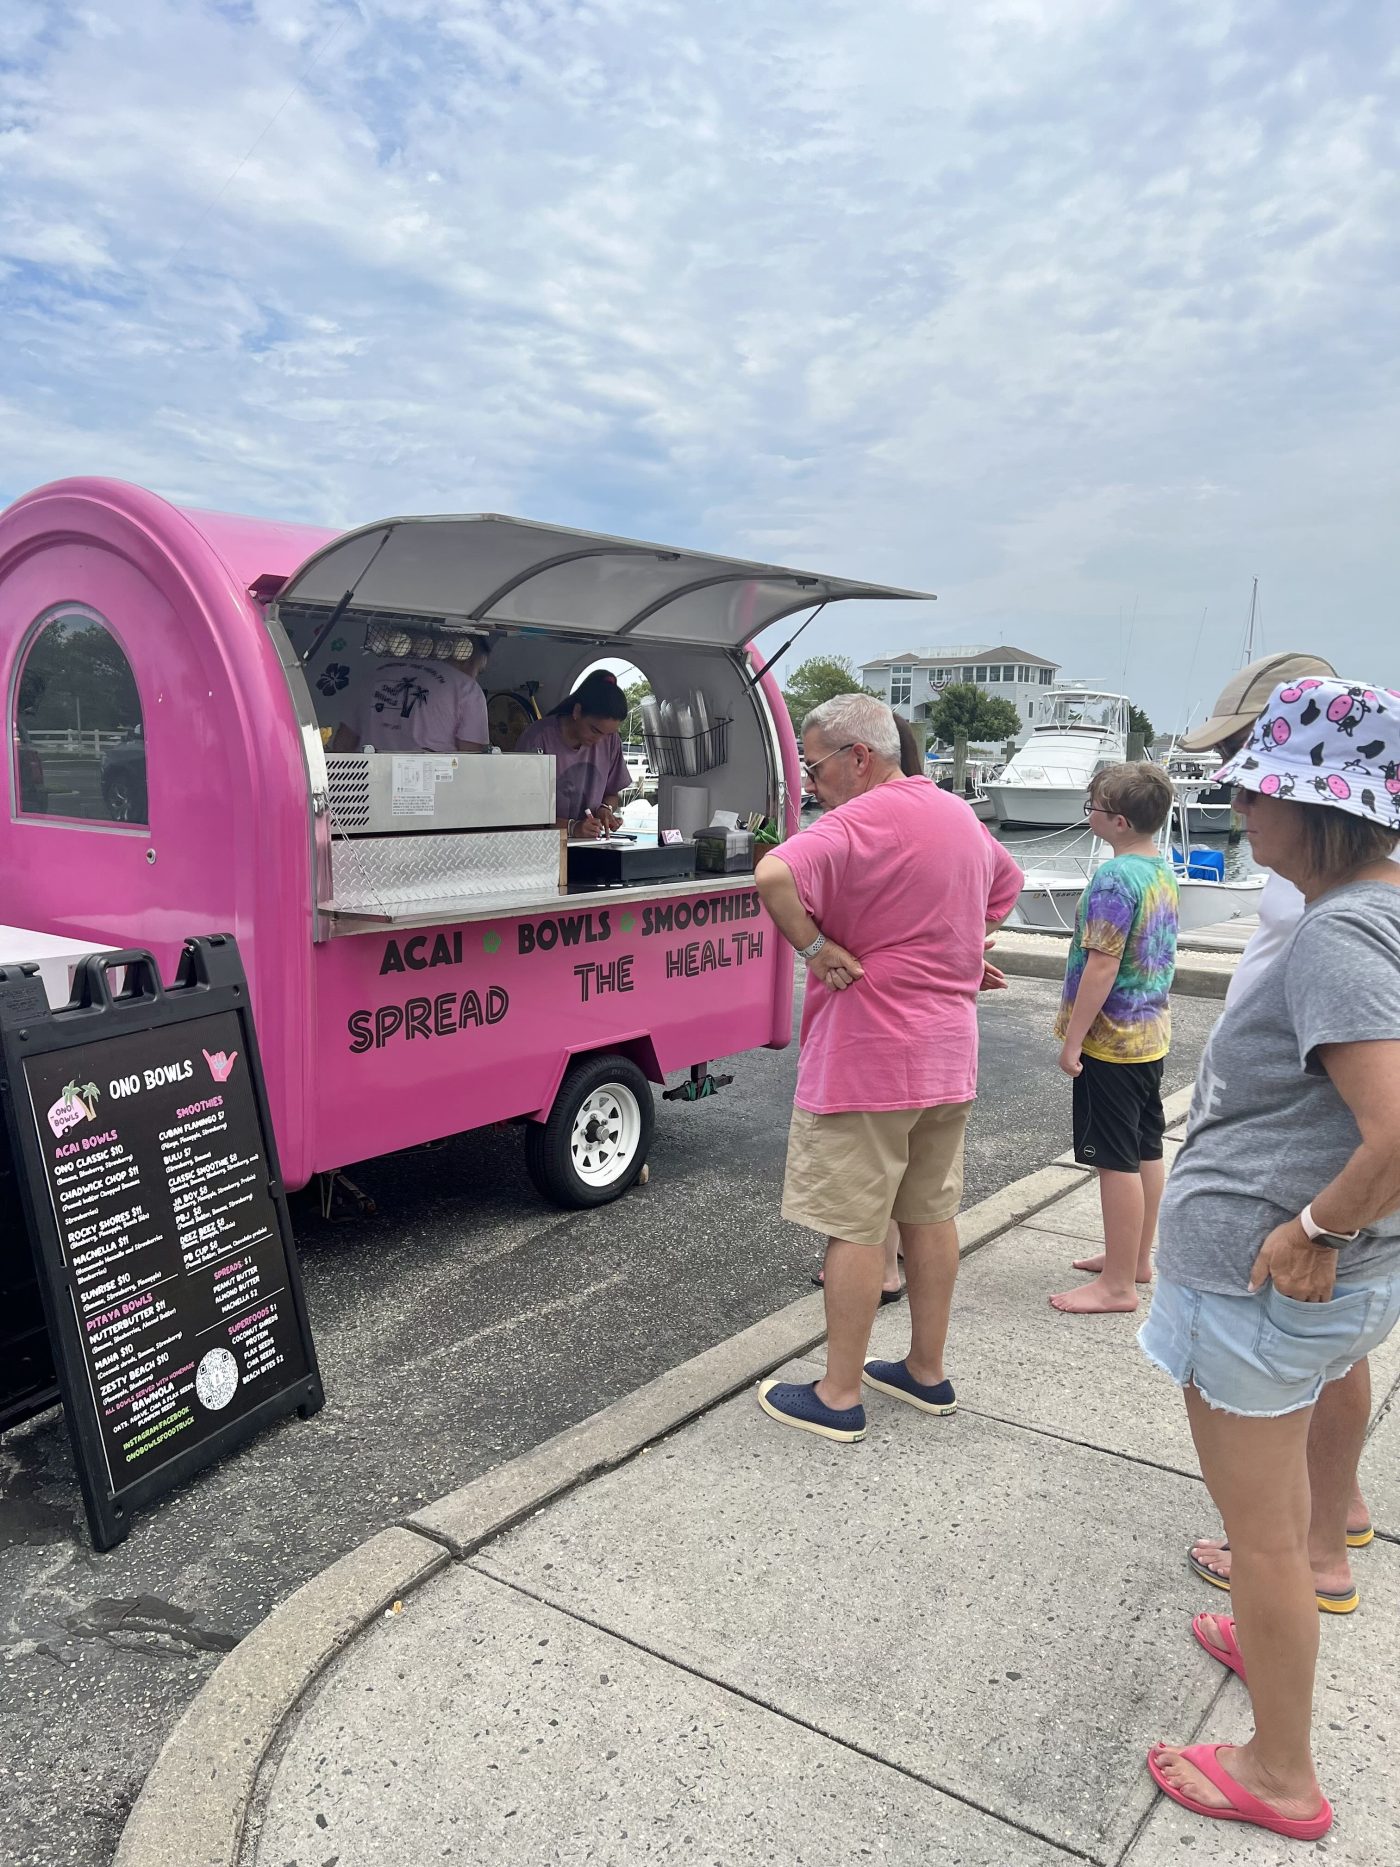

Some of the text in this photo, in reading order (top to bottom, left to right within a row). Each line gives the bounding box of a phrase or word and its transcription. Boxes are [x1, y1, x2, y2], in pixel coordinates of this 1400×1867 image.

[379, 891, 761, 976] ACAI BOWLS SMOOTHIES
[348, 931, 764, 1054] SPREAD THE HEALTH
[110, 1060, 193, 1099] ONO BOWLS
[54, 1112, 79, 1127] BOWLS
[56, 1105, 72, 1116] ONO
[177, 1096, 223, 1118] SMOOTHIES
[159, 1111, 225, 1141] CUBAN FLAMINGO $7
[56, 1130, 117, 1158] ACAI BOWLS
[164, 1147, 191, 1165] BULU $7
[54, 1145, 124, 1176] ONO CLASSIC $10
[168, 1170, 195, 1187] CLASSIC
[196, 1157, 229, 1176] SMOOTHIE
[60, 1166, 139, 1202] CHADWICK CHOP $11
[183, 1191, 199, 1203] BOY
[68, 1206, 142, 1242] ROCKY SHORES $11
[198, 1222, 216, 1236] BEEZ
[73, 1235, 129, 1266] MACNELLA $11
[184, 1253, 194, 1263] PB
[195, 1246, 209, 1258] CUP
[81, 1273, 131, 1302] SUNRISE $10
[213, 1266, 258, 1293] PEANUT BUTTER
[215, 1276, 260, 1303] ALMOND BUTTER
[87, 1293, 153, 1331] PITAYA BOWLS
[90, 1300, 166, 1344] NUTTERBUTTER $11
[228, 1307, 269, 1335] SUPERFOODS
[232, 1325, 258, 1344] COCONUT
[246, 1330, 269, 1347] PROTEIN
[95, 1344, 134, 1370] MAHA $10
[244, 1347, 258, 1359] FLAX
[100, 1352, 169, 1396] ZESTY BEACH $10
[242, 1369, 260, 1384] BEACH
[261, 1360, 276, 1373] BITES
[106, 1407, 115, 1416] ALL
[116, 1396, 135, 1410] BOWLS
[136, 1385, 155, 1399] SERVED
[156, 1377, 169, 1387] WITH
[132, 1383, 174, 1412] RAWNOLA
